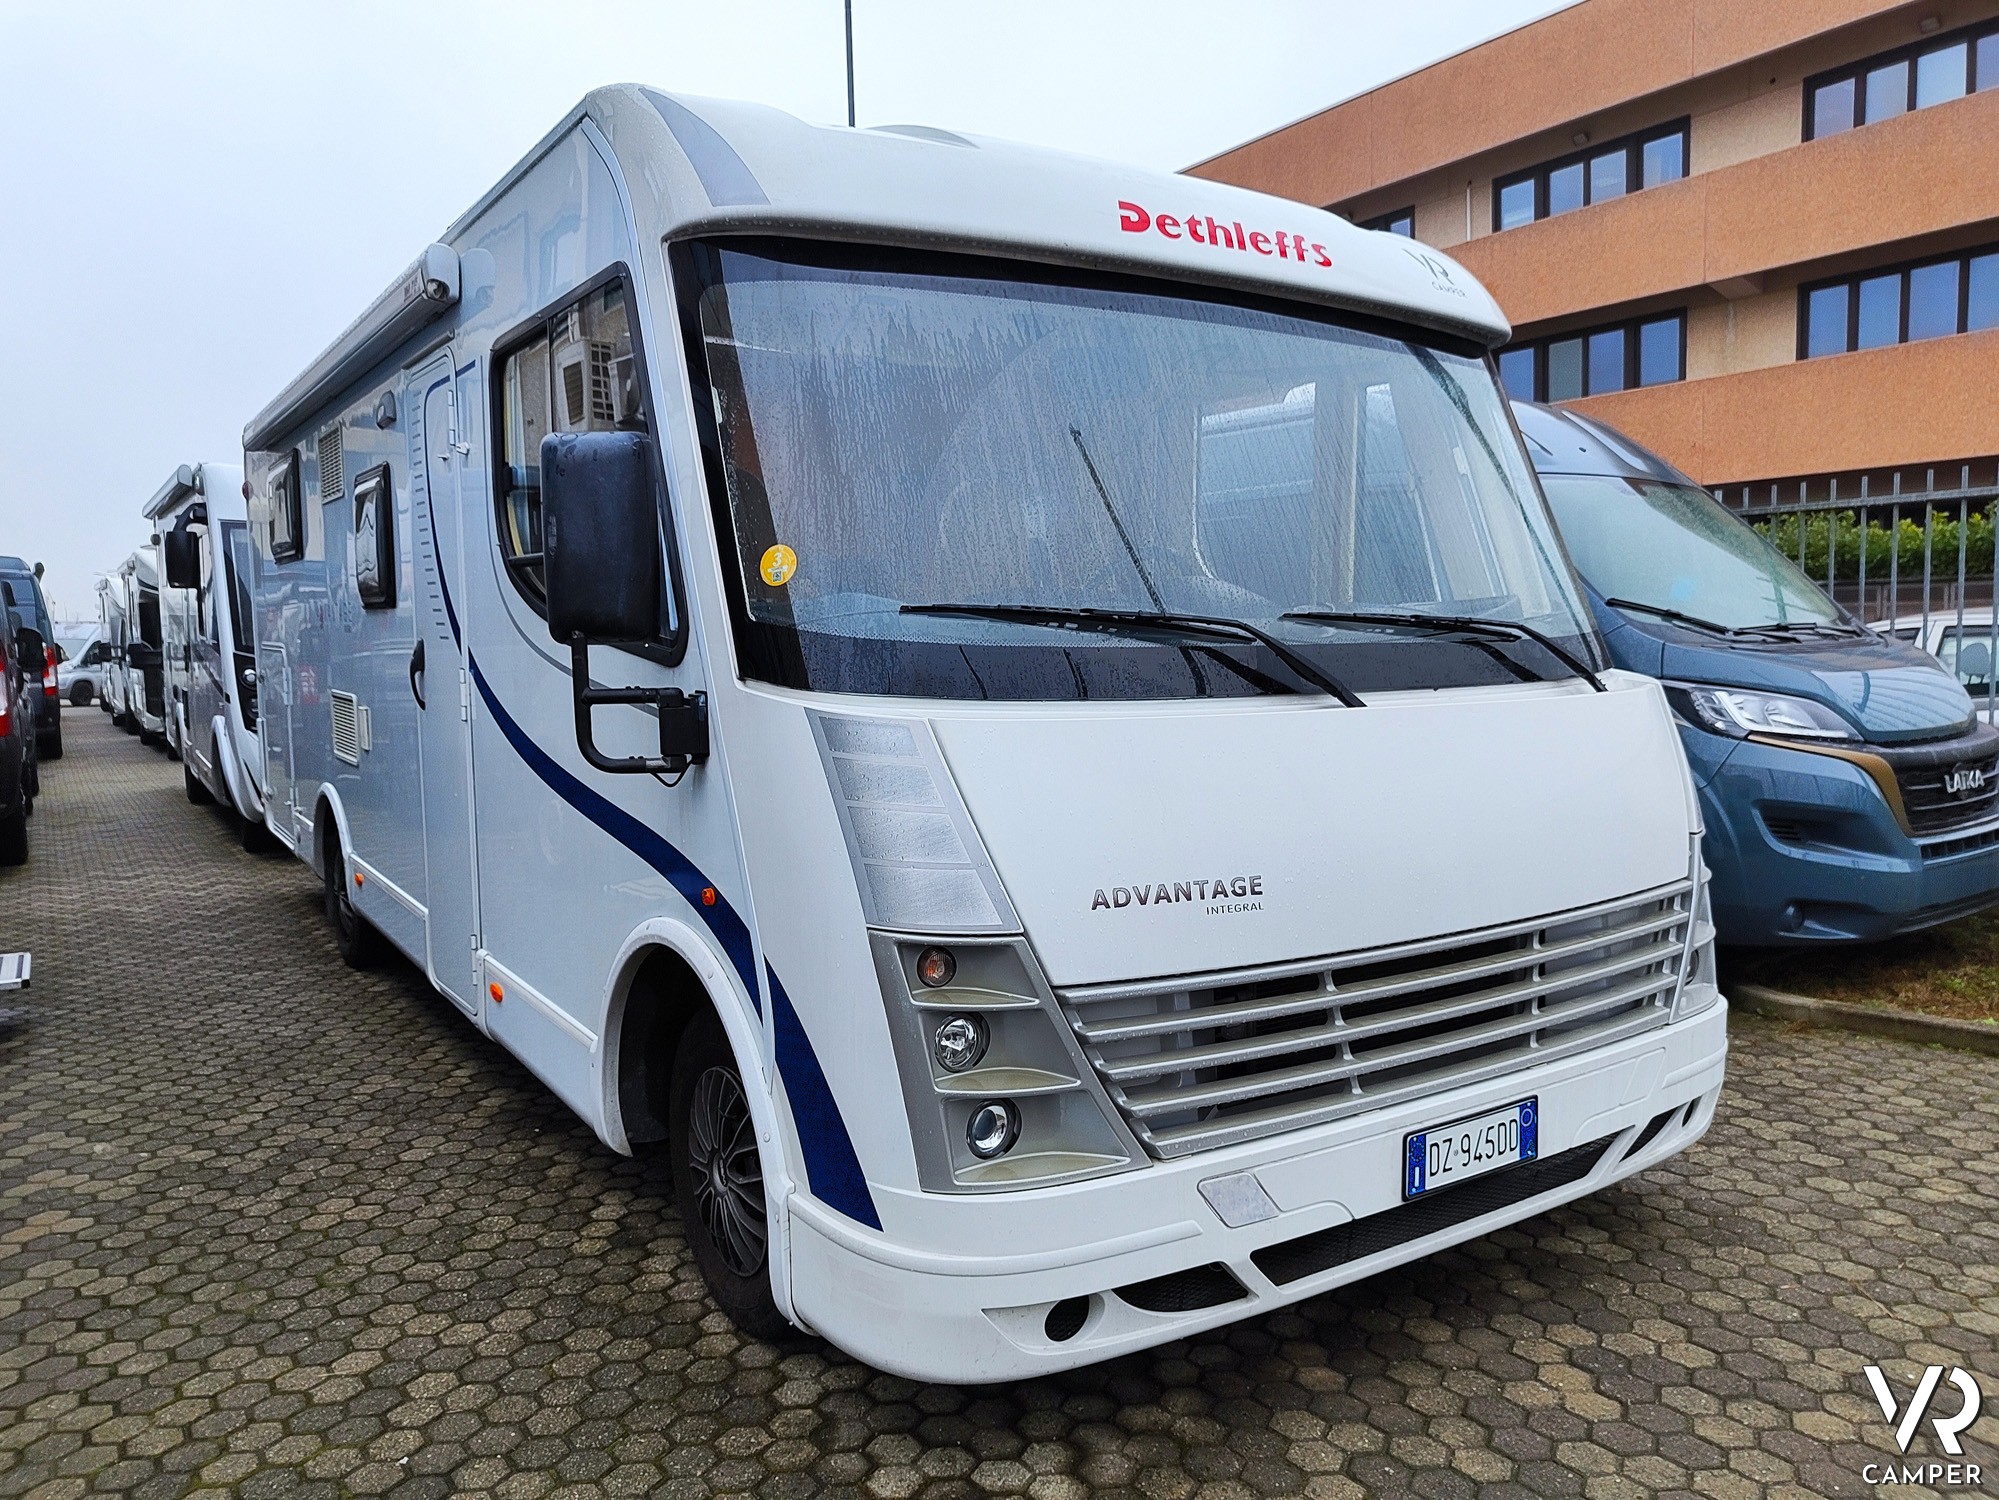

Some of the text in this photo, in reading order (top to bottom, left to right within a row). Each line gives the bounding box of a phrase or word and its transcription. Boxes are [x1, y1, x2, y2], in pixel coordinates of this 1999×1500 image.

[1118, 200, 1333, 267] Dethleffs
[1944, 769, 1985, 794] LAIKA
[1091, 875, 1263, 910] ADVANTAGE
[1206, 902, 1265, 916] INTEGRAL
